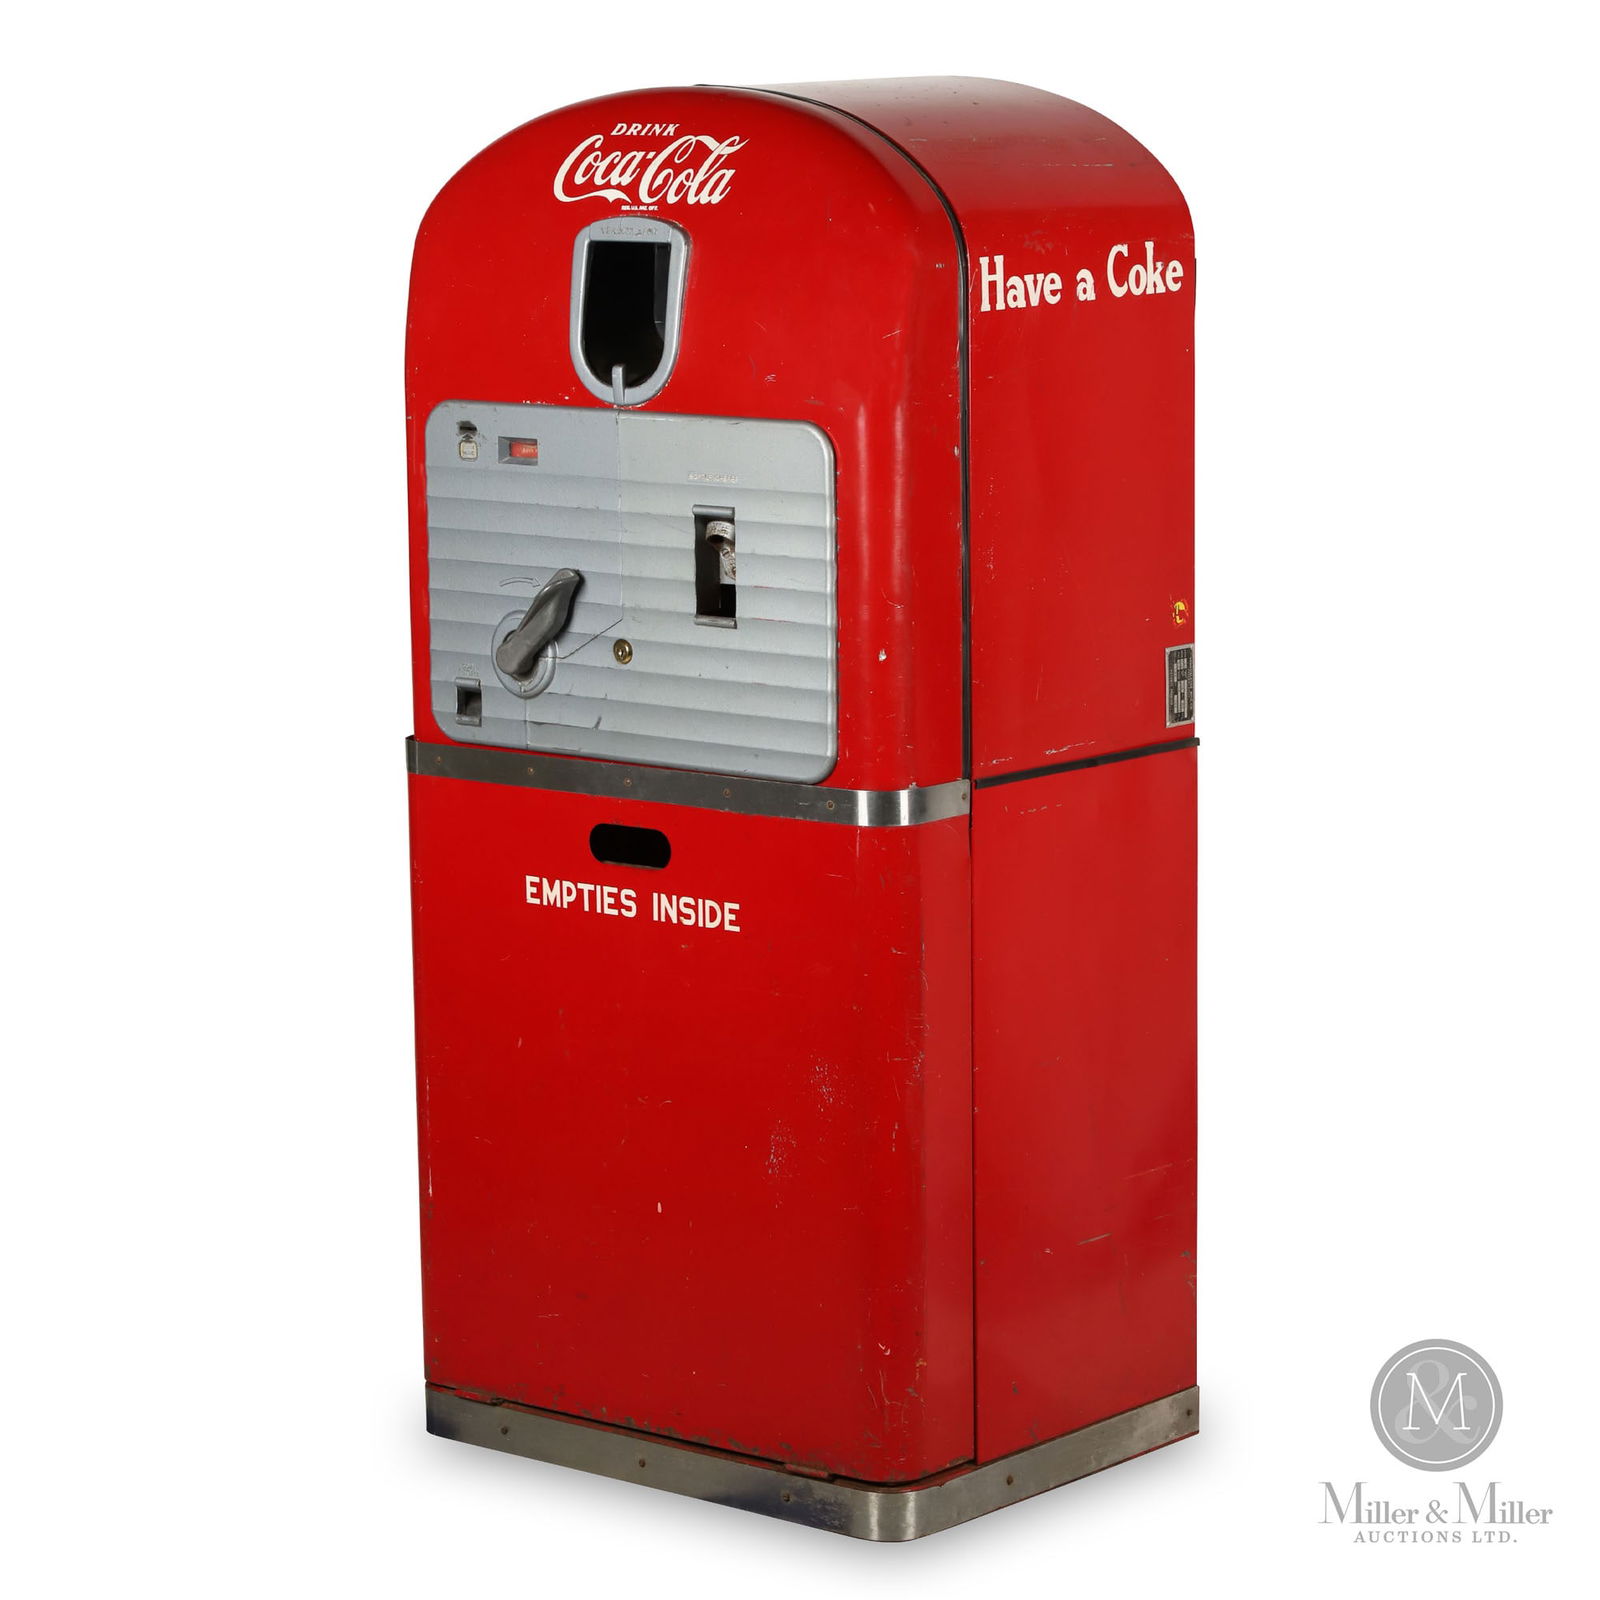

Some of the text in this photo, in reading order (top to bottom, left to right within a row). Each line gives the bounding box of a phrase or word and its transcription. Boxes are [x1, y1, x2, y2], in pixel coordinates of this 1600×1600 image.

[610, 123, 680, 137] DRINK
[553, 134, 750, 205] Coca-Cola
[979, 241, 1184, 312] Have a Coke
[525, 874, 741, 933] EMPTIES INSIDE
